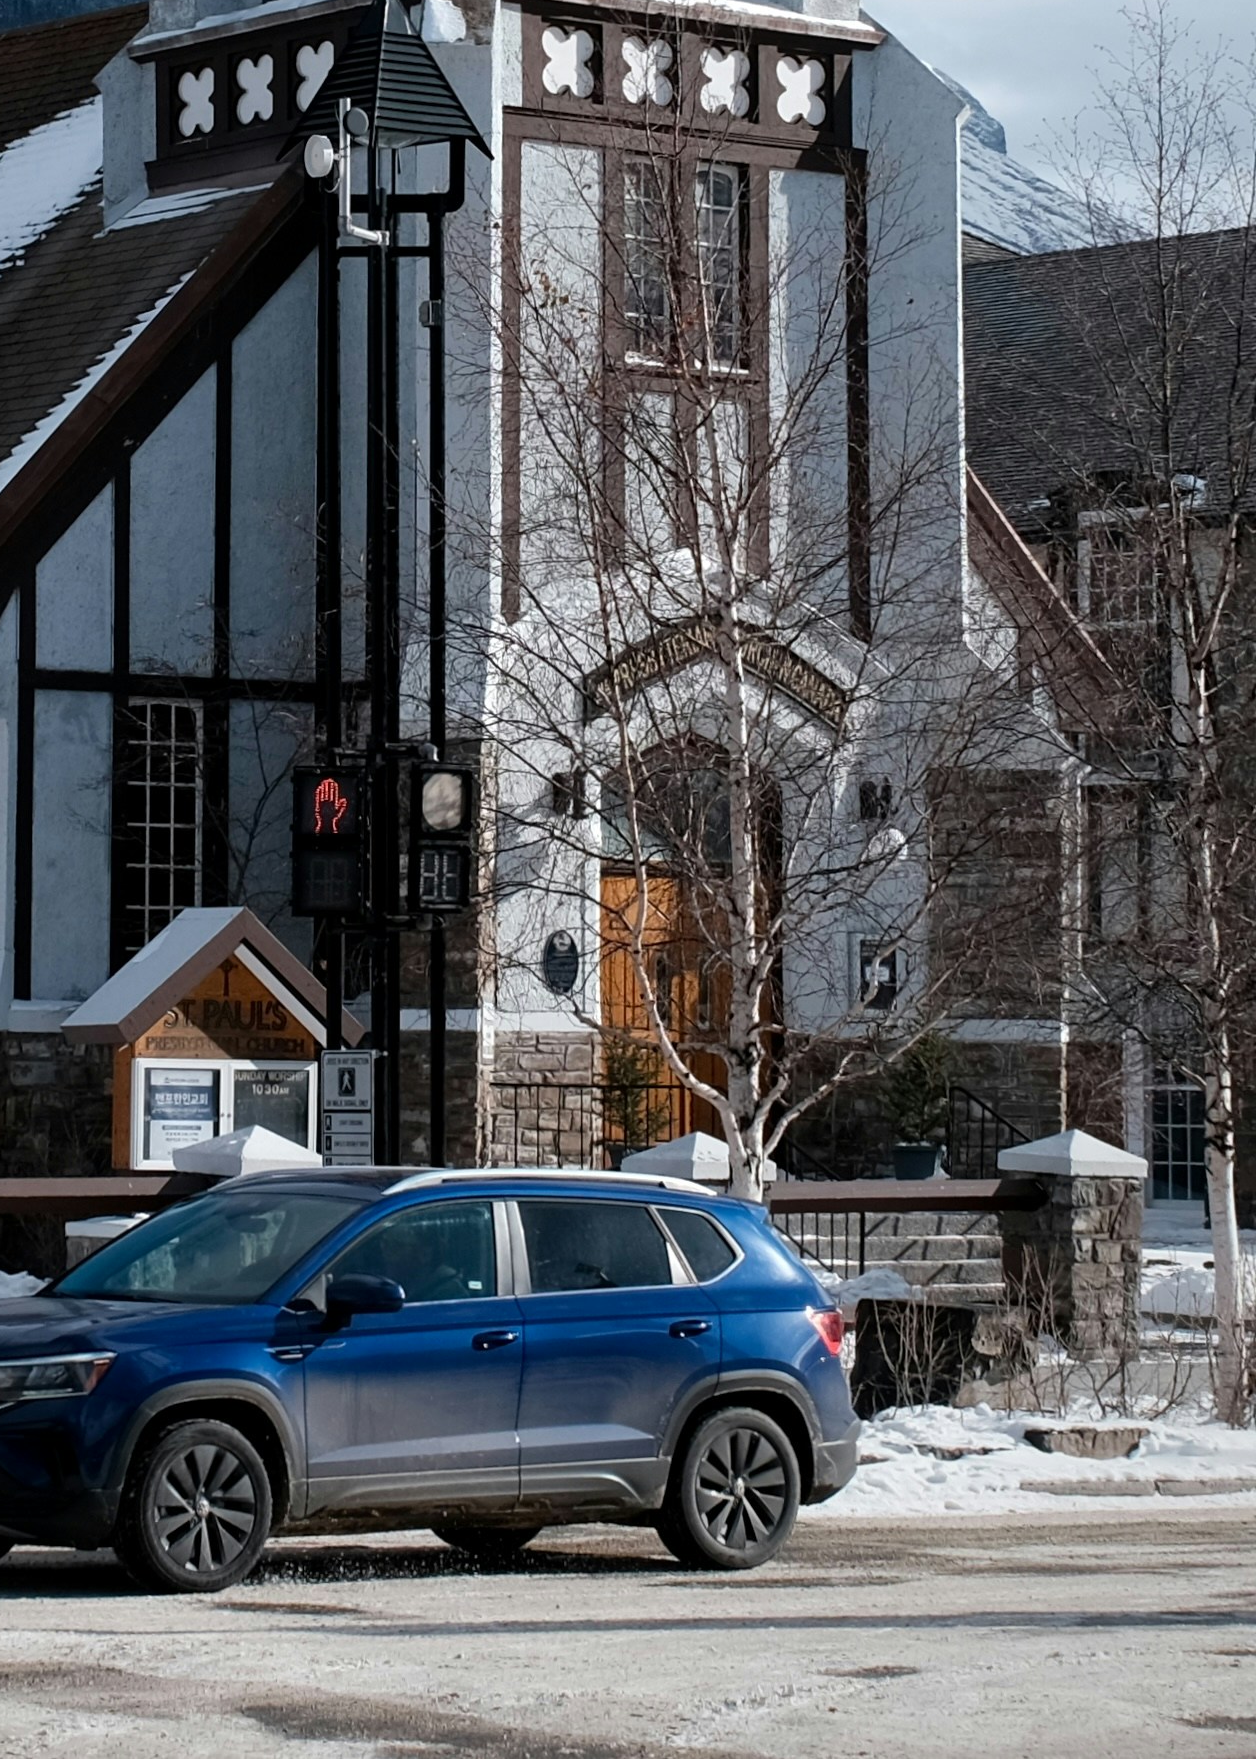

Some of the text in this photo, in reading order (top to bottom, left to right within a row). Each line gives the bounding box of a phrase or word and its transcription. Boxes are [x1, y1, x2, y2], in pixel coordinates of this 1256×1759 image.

[203, 999, 287, 1031] PAUL'S
[246, 1036, 305, 1054] CHURCH
[234, 1071, 305, 1082] SUNDAY WORSHIP
